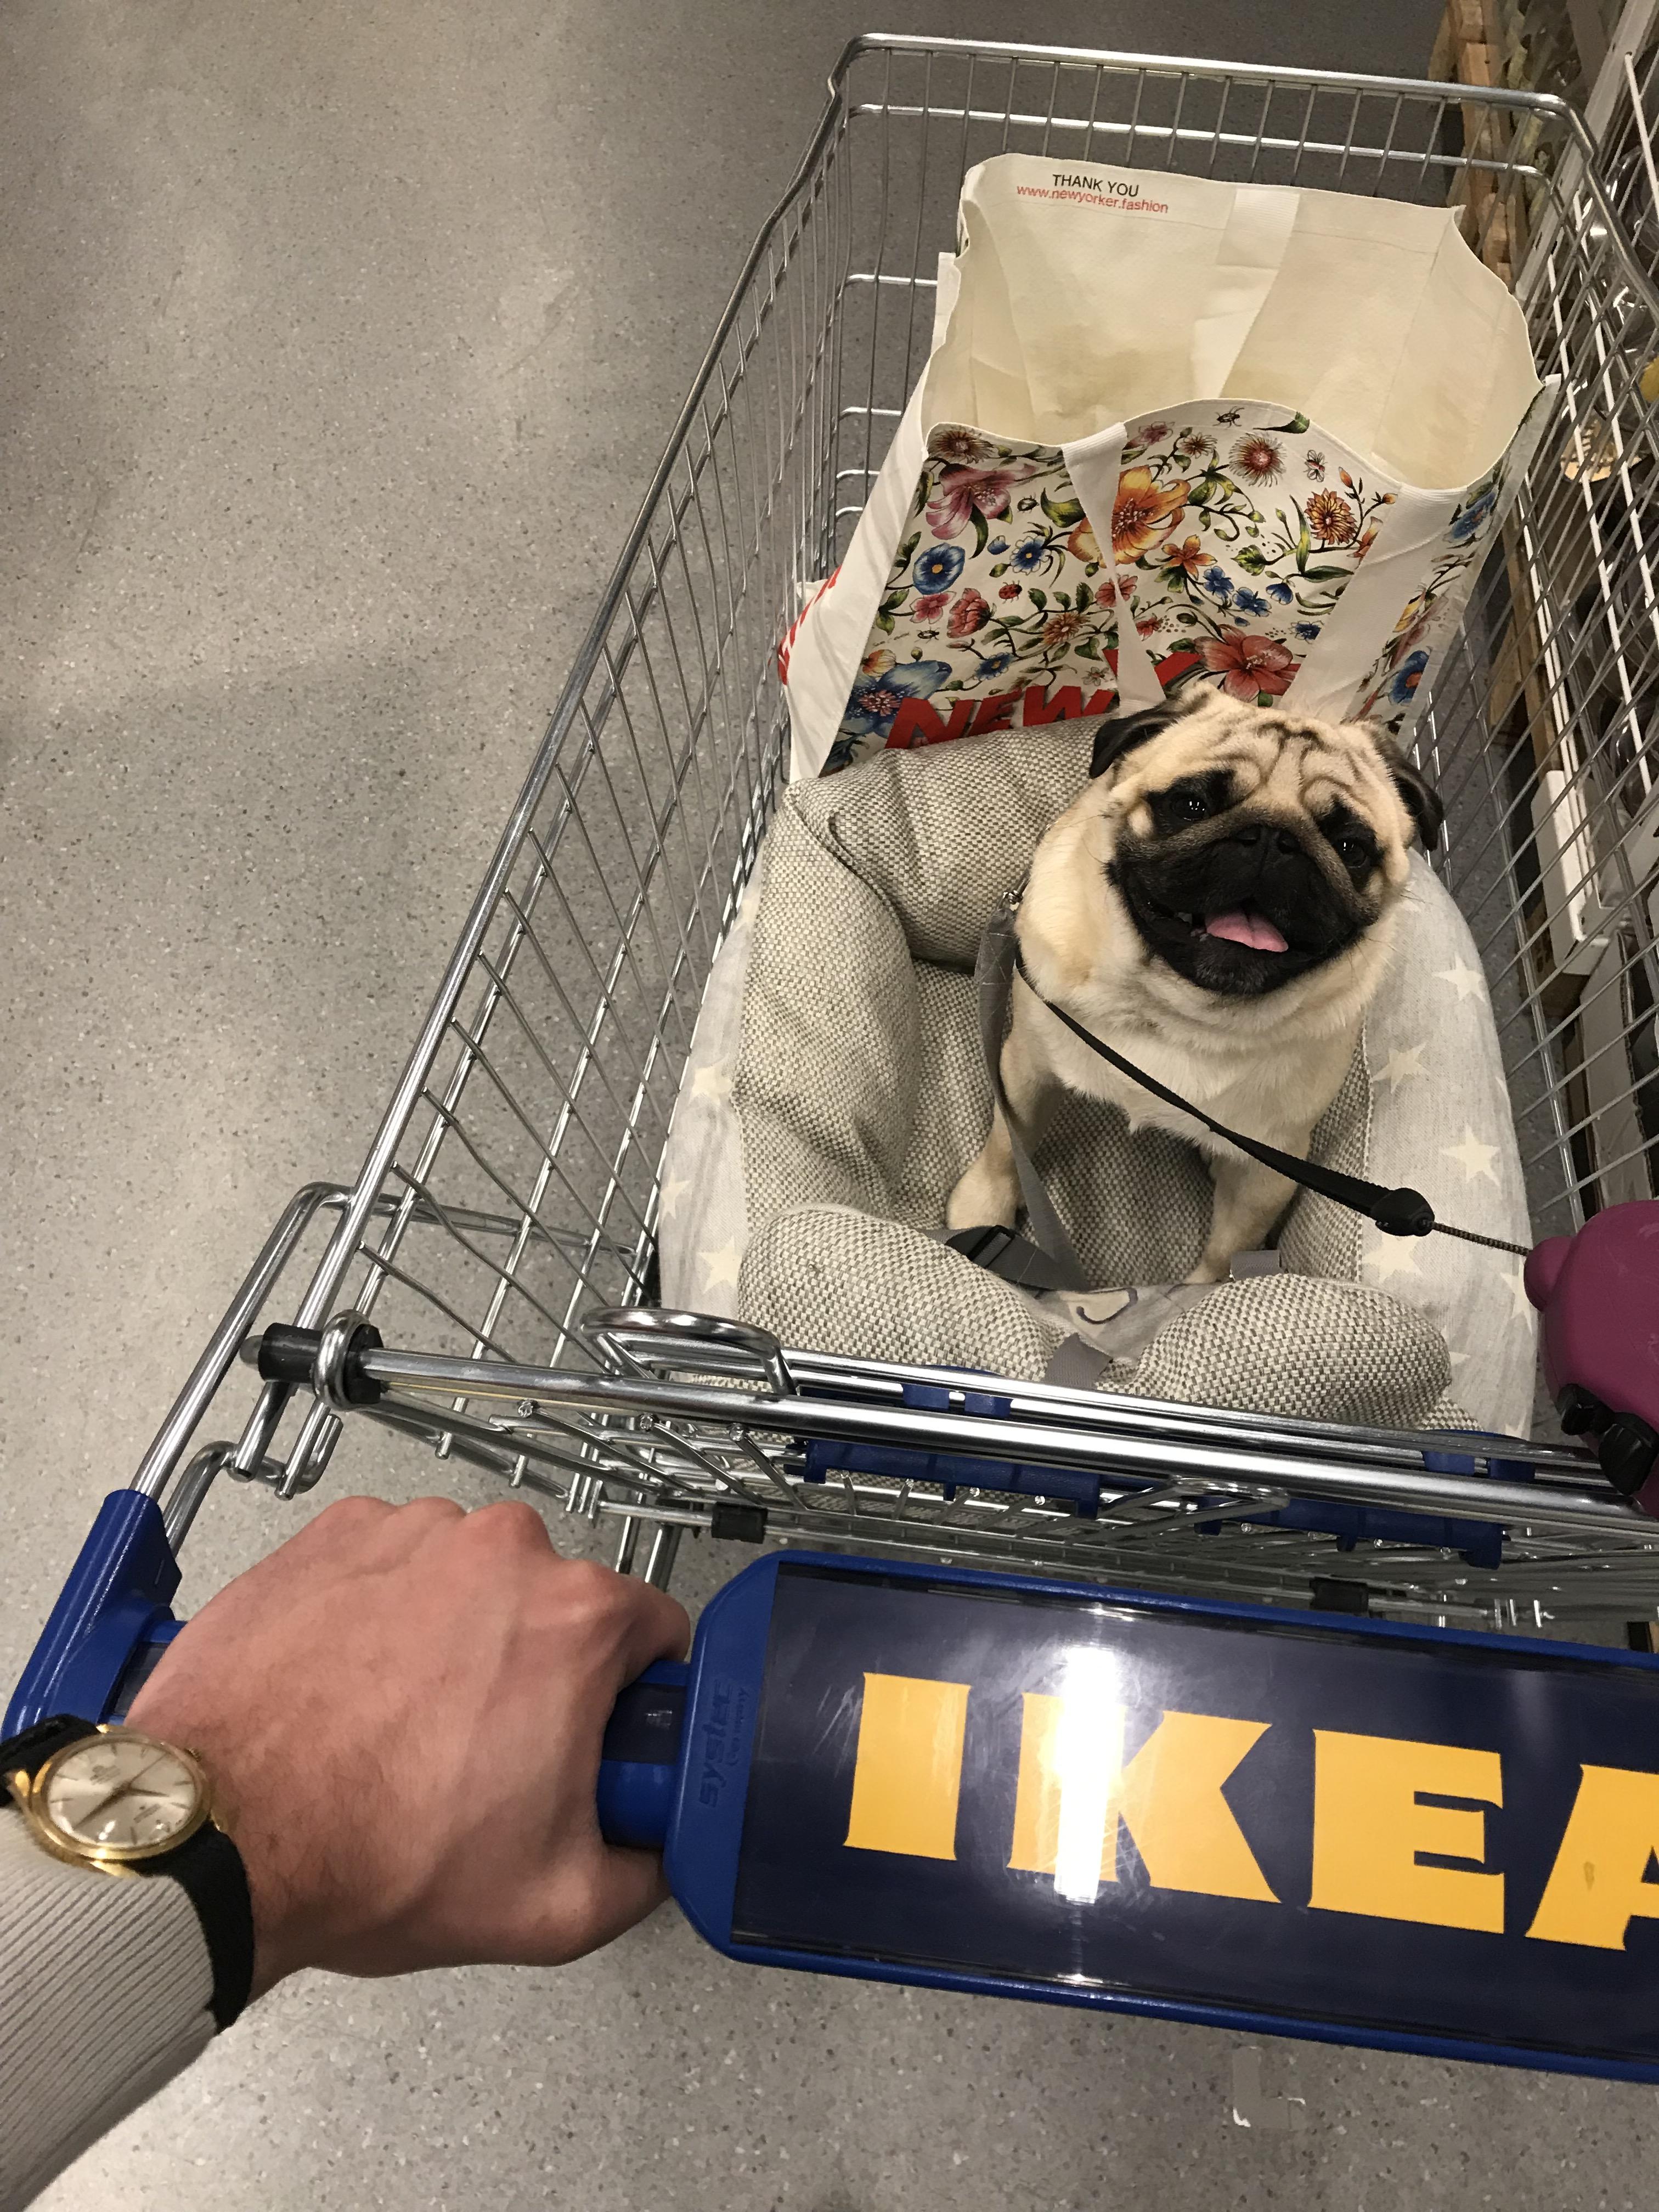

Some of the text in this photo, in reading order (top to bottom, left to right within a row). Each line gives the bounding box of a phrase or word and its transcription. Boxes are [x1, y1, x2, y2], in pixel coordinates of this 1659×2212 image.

[1016, 185, 1169, 213] www.newyorker.fashion
[1052, 173, 1139, 198] THANK YOU
[884, 685, 1115, 750] NEW
